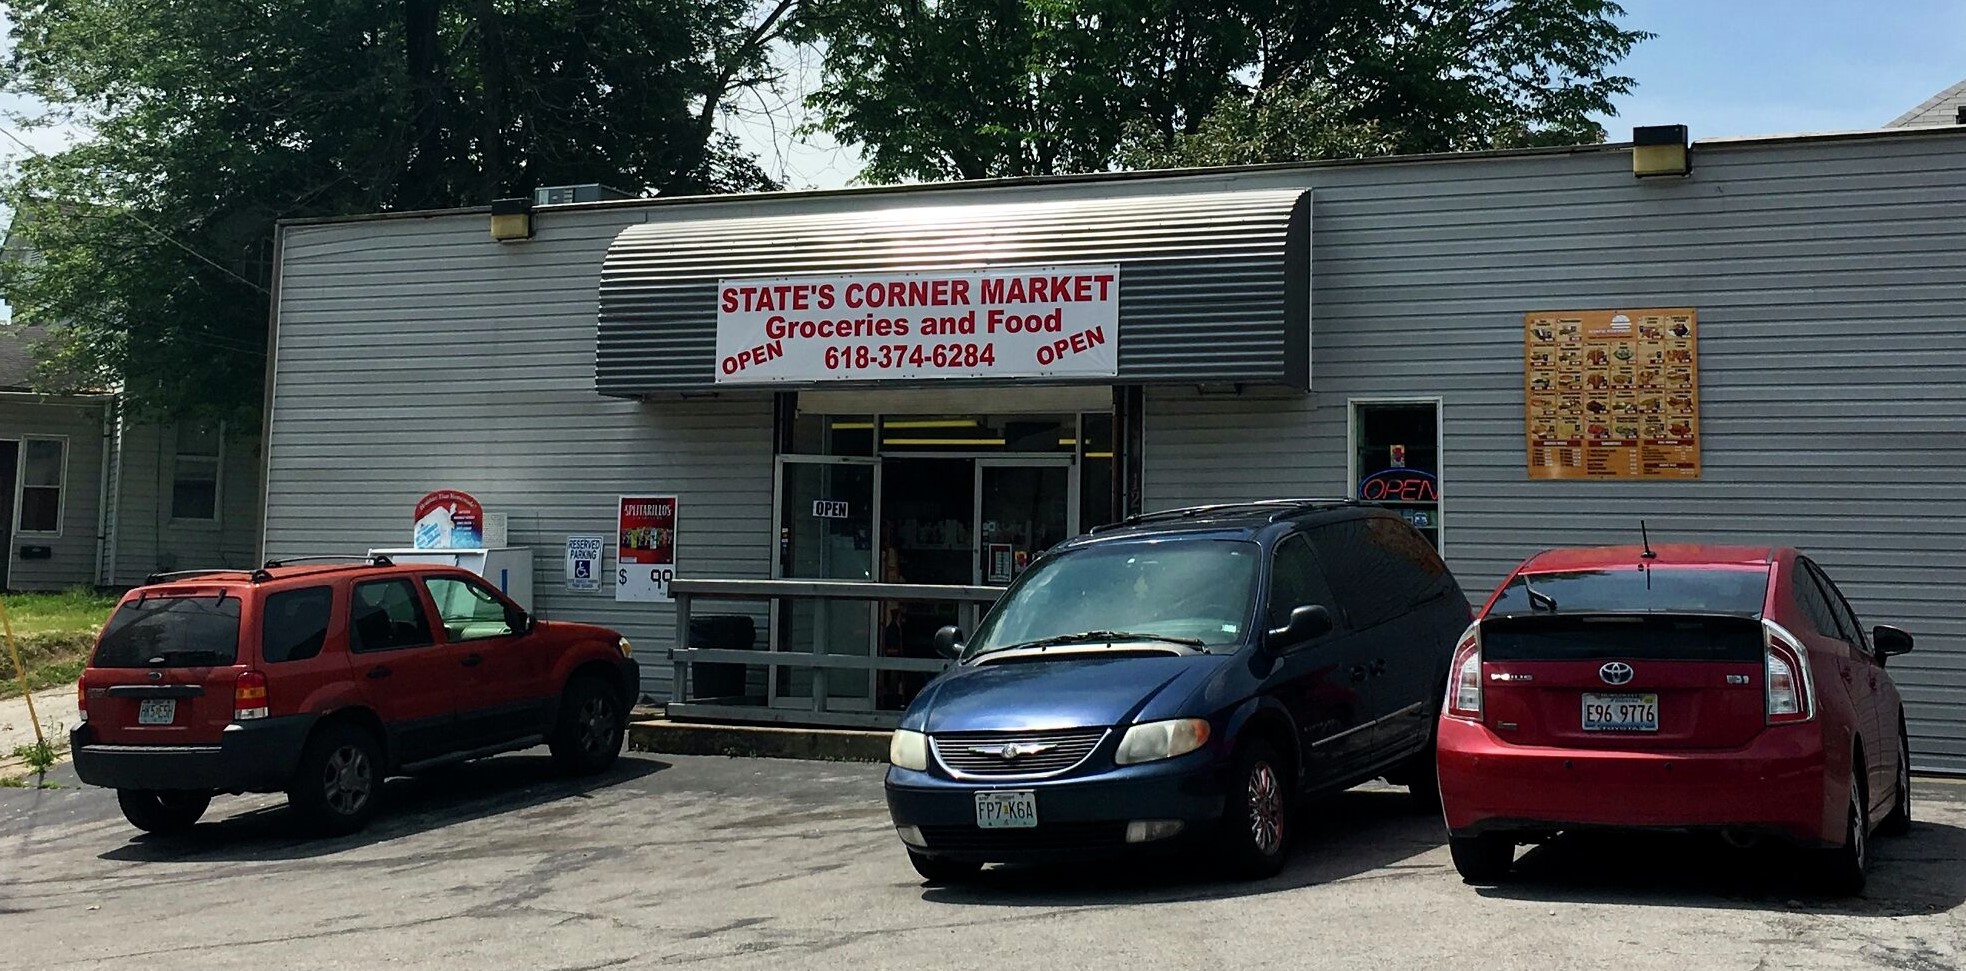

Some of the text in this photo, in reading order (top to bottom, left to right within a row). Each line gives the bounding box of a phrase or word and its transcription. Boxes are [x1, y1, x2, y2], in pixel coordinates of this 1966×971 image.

[721, 274, 1114, 314] STATE'S CORNER MARKET
[765, 307, 1062, 339] Groceries and Food
[824, 342, 996, 370] 618-374-6284
[1035, 325, 1106, 366] OPEN
[721, 339, 784, 375] OPEN
[1364, 478, 1439, 501] OPEN
[624, 504, 672, 516] SPLITARILLOS
[815, 501, 847, 518] OPEN
[568, 539, 600, 551] RESERVED
[569, 550, 597, 560] PARKING
[1586, 704, 1655, 723] E96 9776
[978, 801, 1034, 820] FP7 K6A
